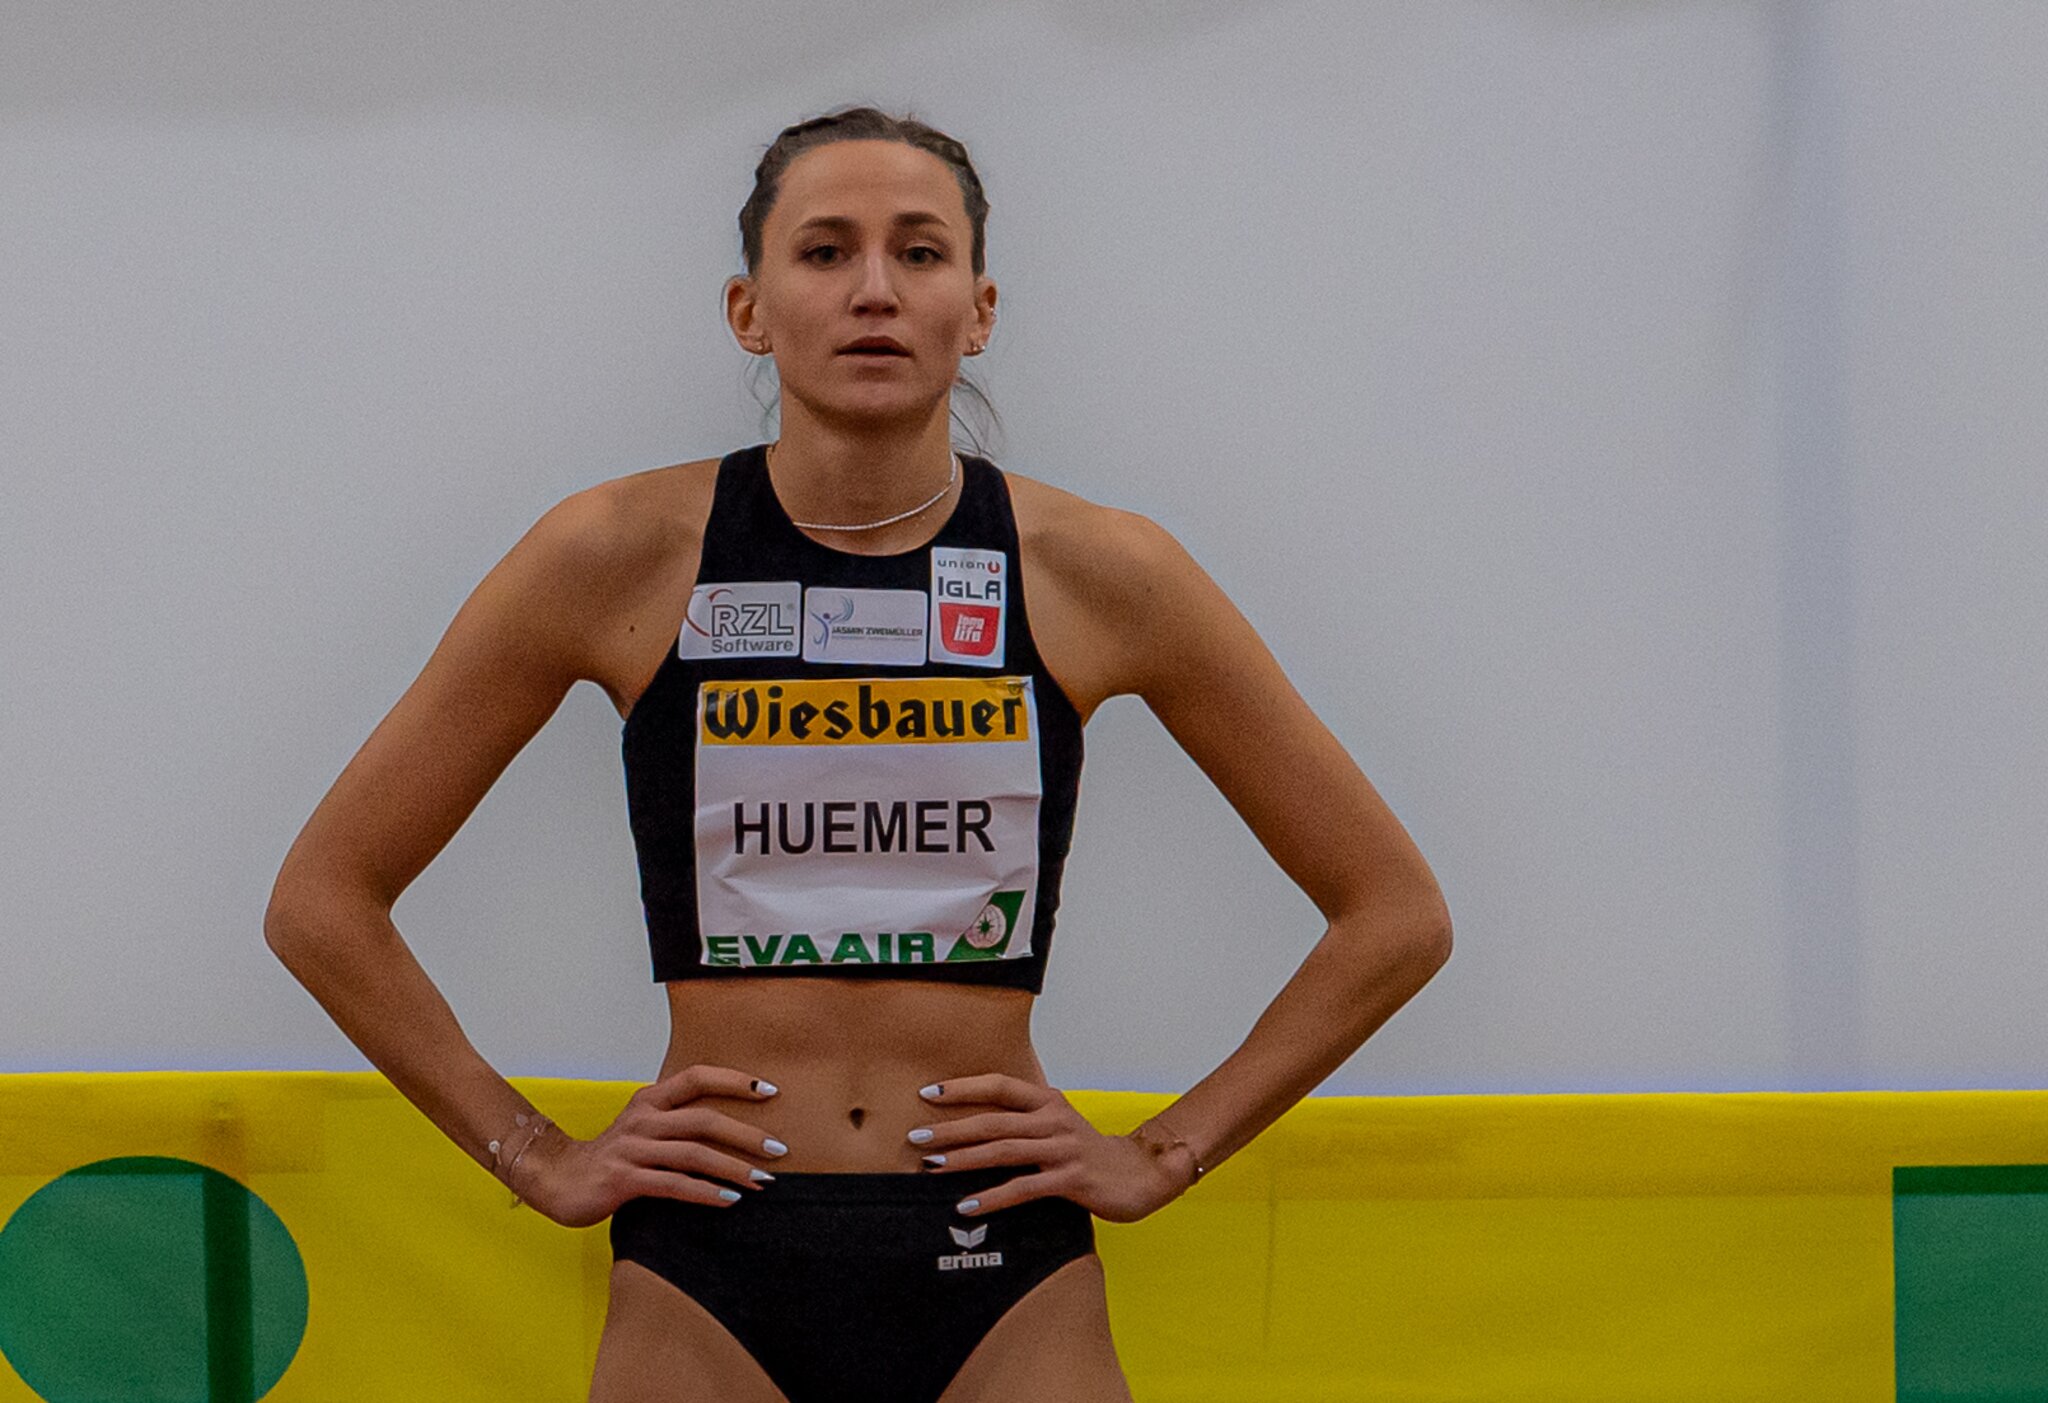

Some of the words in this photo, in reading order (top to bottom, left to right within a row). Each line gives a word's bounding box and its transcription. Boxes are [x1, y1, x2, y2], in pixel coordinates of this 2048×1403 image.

[937, 559, 986, 570] union
[938, 576, 1001, 601] IGLA
[711, 603, 794, 637] RZL
[711, 637, 794, 654] Software
[704, 684, 1022, 740] Wiesbauer
[734, 800, 996, 855] HUEMER
[937, 1250, 1003, 1271] erima
